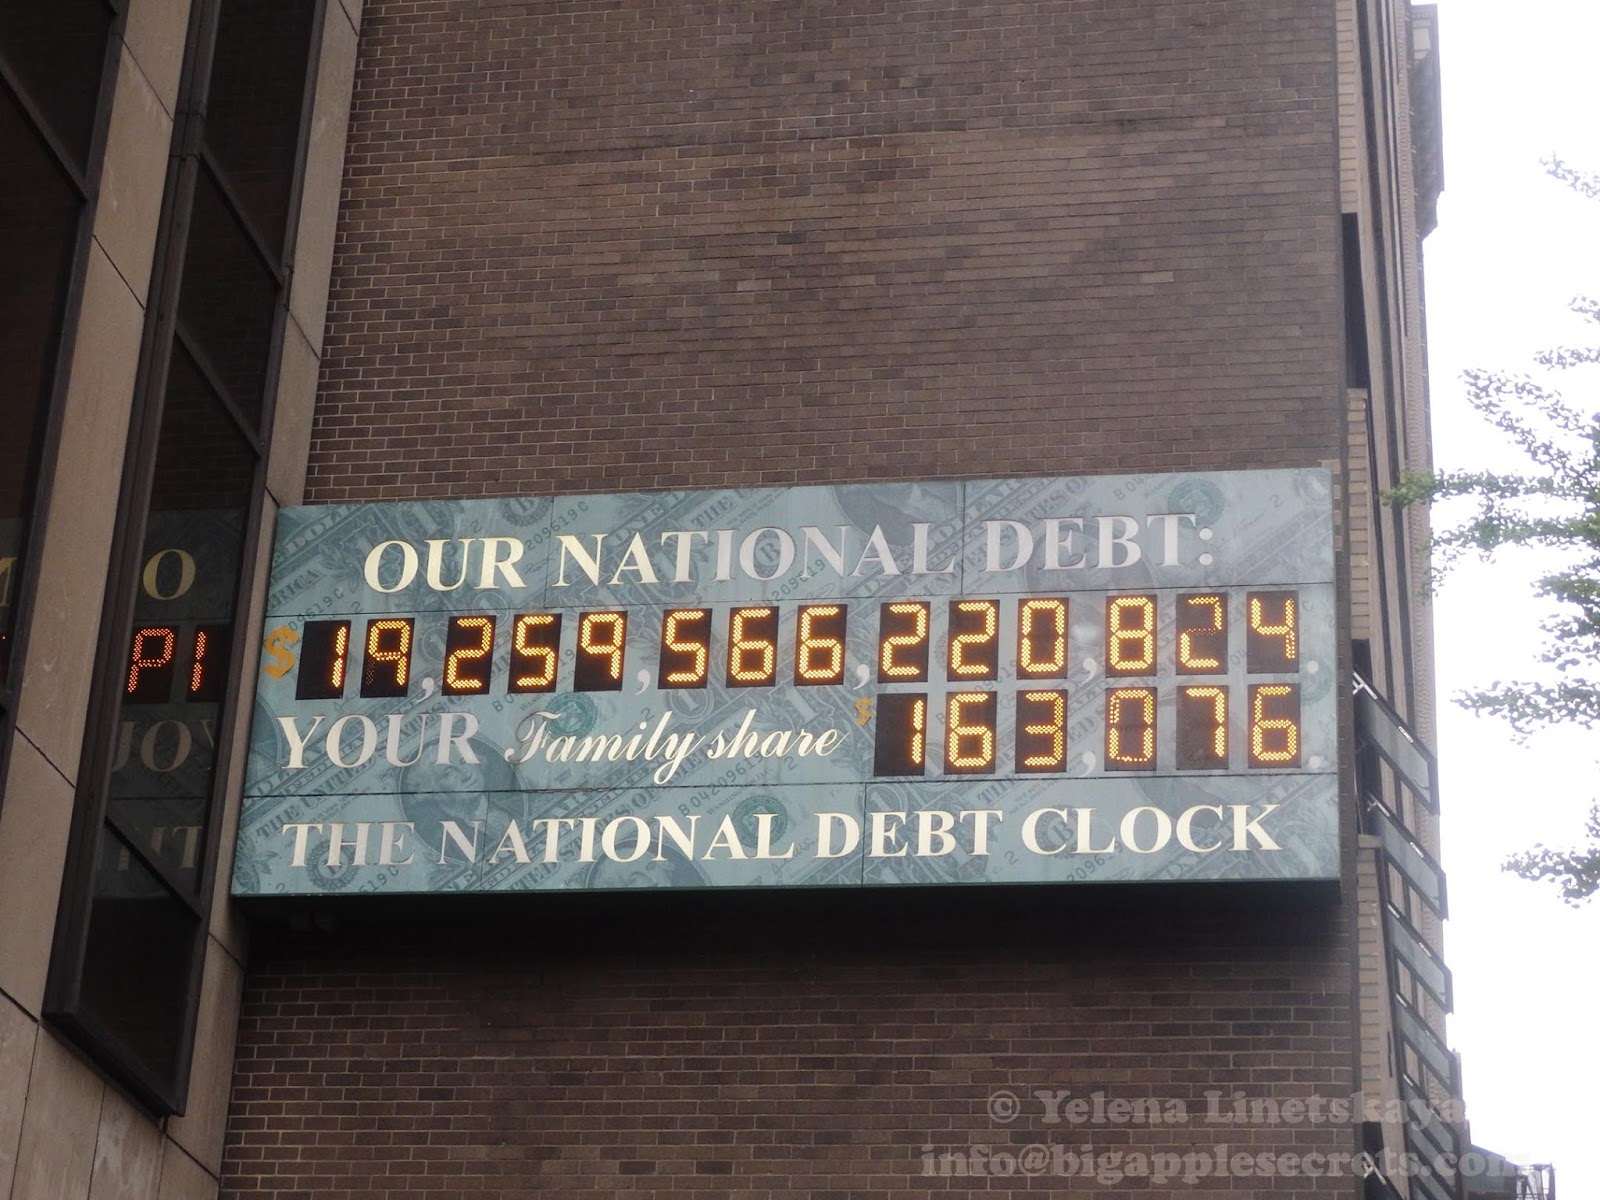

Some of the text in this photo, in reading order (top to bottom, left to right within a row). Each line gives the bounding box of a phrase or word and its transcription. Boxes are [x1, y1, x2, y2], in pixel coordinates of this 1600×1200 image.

[364, 536, 528, 593] OUR
[552, 524, 955, 587] NATIONAL
[982, 513, 1213, 573] DEBT:
[277, 709, 850, 785] YOUR Family share
[282, 821, 415, 868] THE
[436, 812, 795, 866] NATIONAL
[812, 810, 1003, 859] DEBT
[1022, 804, 1284, 855] CLOCK
